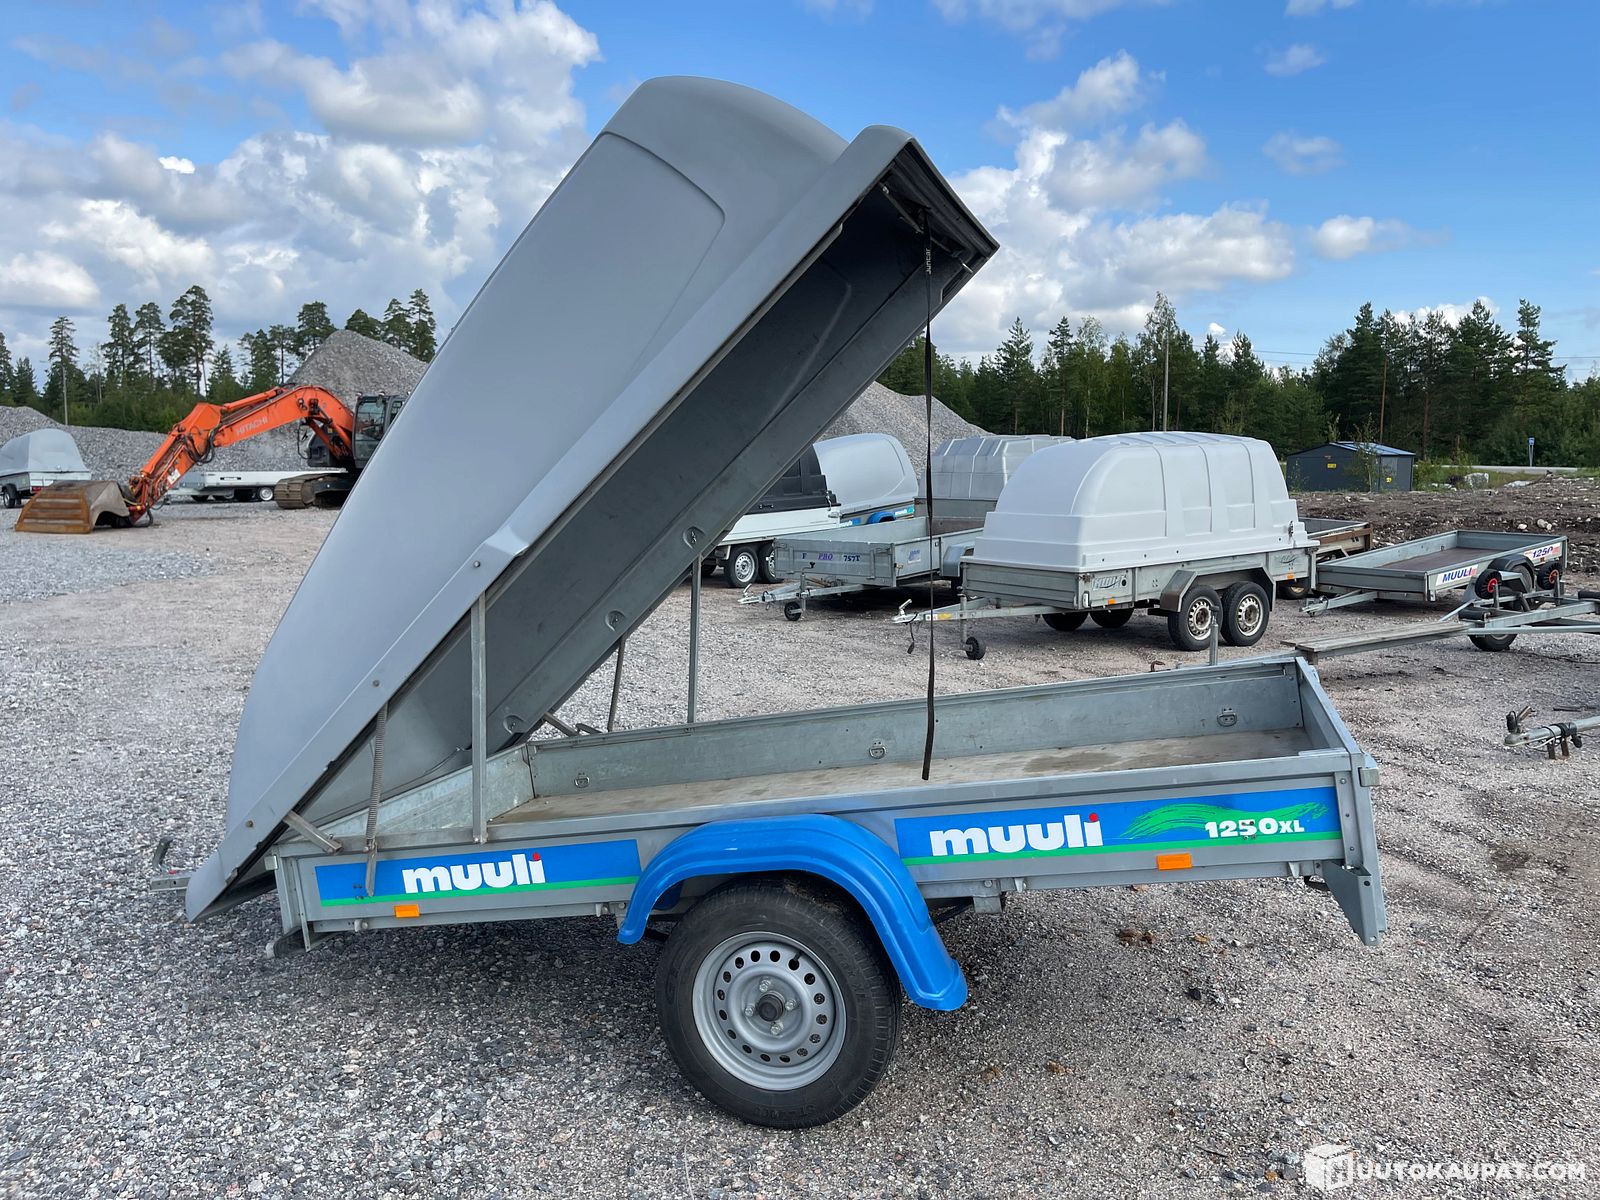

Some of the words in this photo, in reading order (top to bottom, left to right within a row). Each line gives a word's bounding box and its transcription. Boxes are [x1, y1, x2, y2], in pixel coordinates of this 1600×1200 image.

[236, 416, 268, 435] HITACHI
[1442, 567, 1472, 583] MUULI
[929, 813, 1104, 857] muuli
[1204, 817, 1305, 838] 1250XL
[401, 851, 546, 894] muuli
